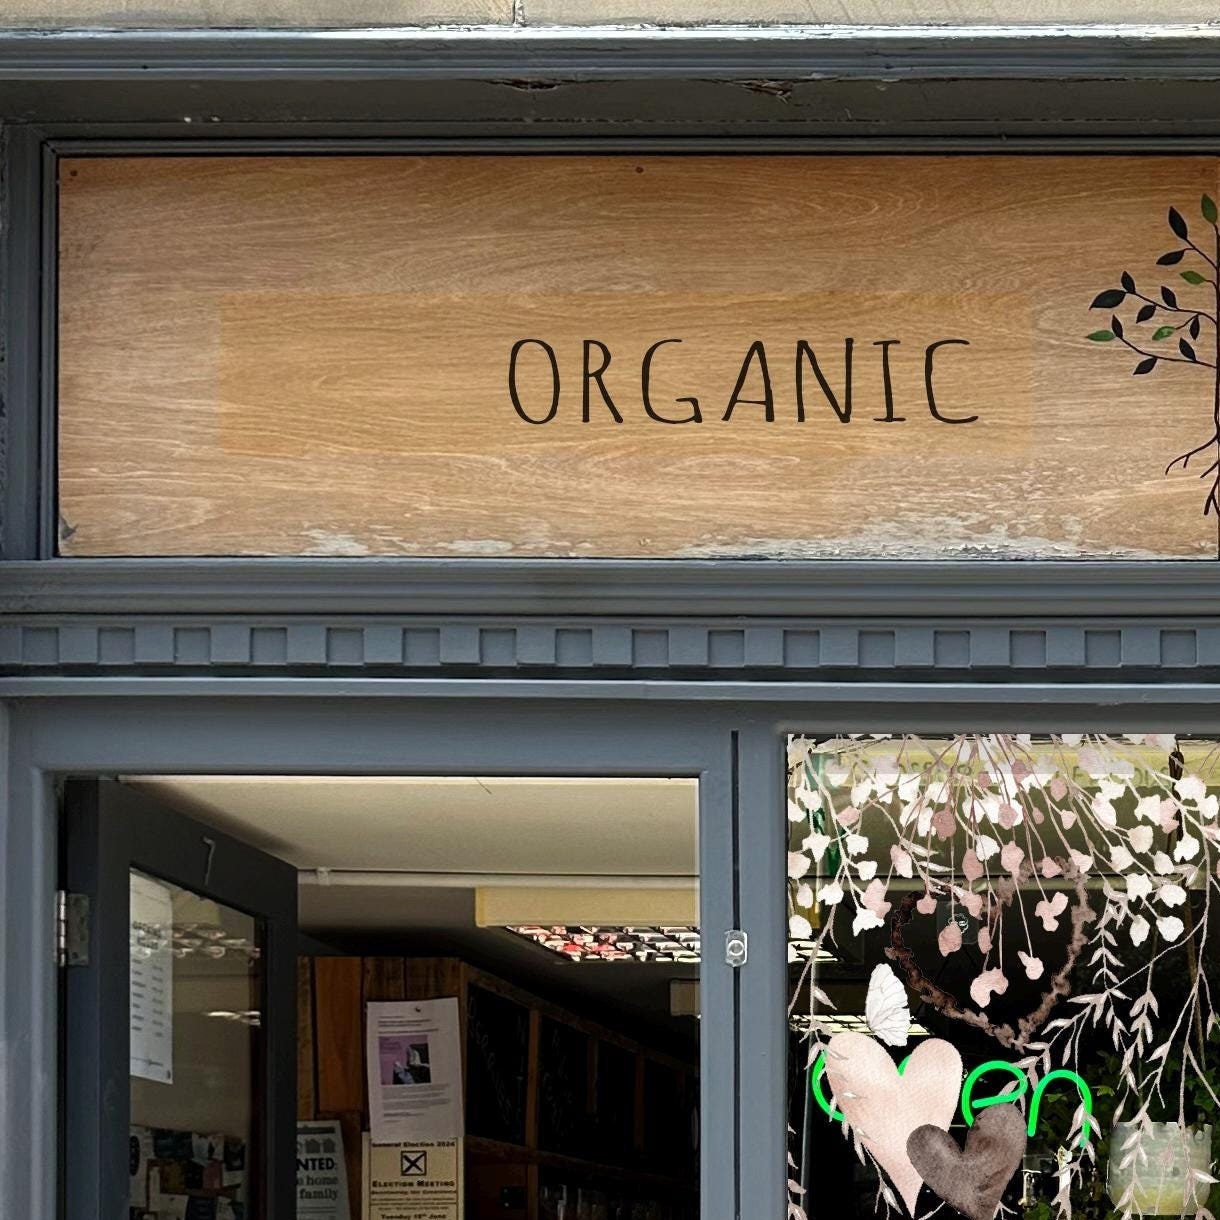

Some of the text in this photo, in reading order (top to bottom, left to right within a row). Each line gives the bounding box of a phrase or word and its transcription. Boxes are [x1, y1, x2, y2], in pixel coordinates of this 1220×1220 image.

[508, 337, 979, 425] ORGANIC
[811, 1048, 1094, 1148] en
[300, 1188, 338, 1201] family
